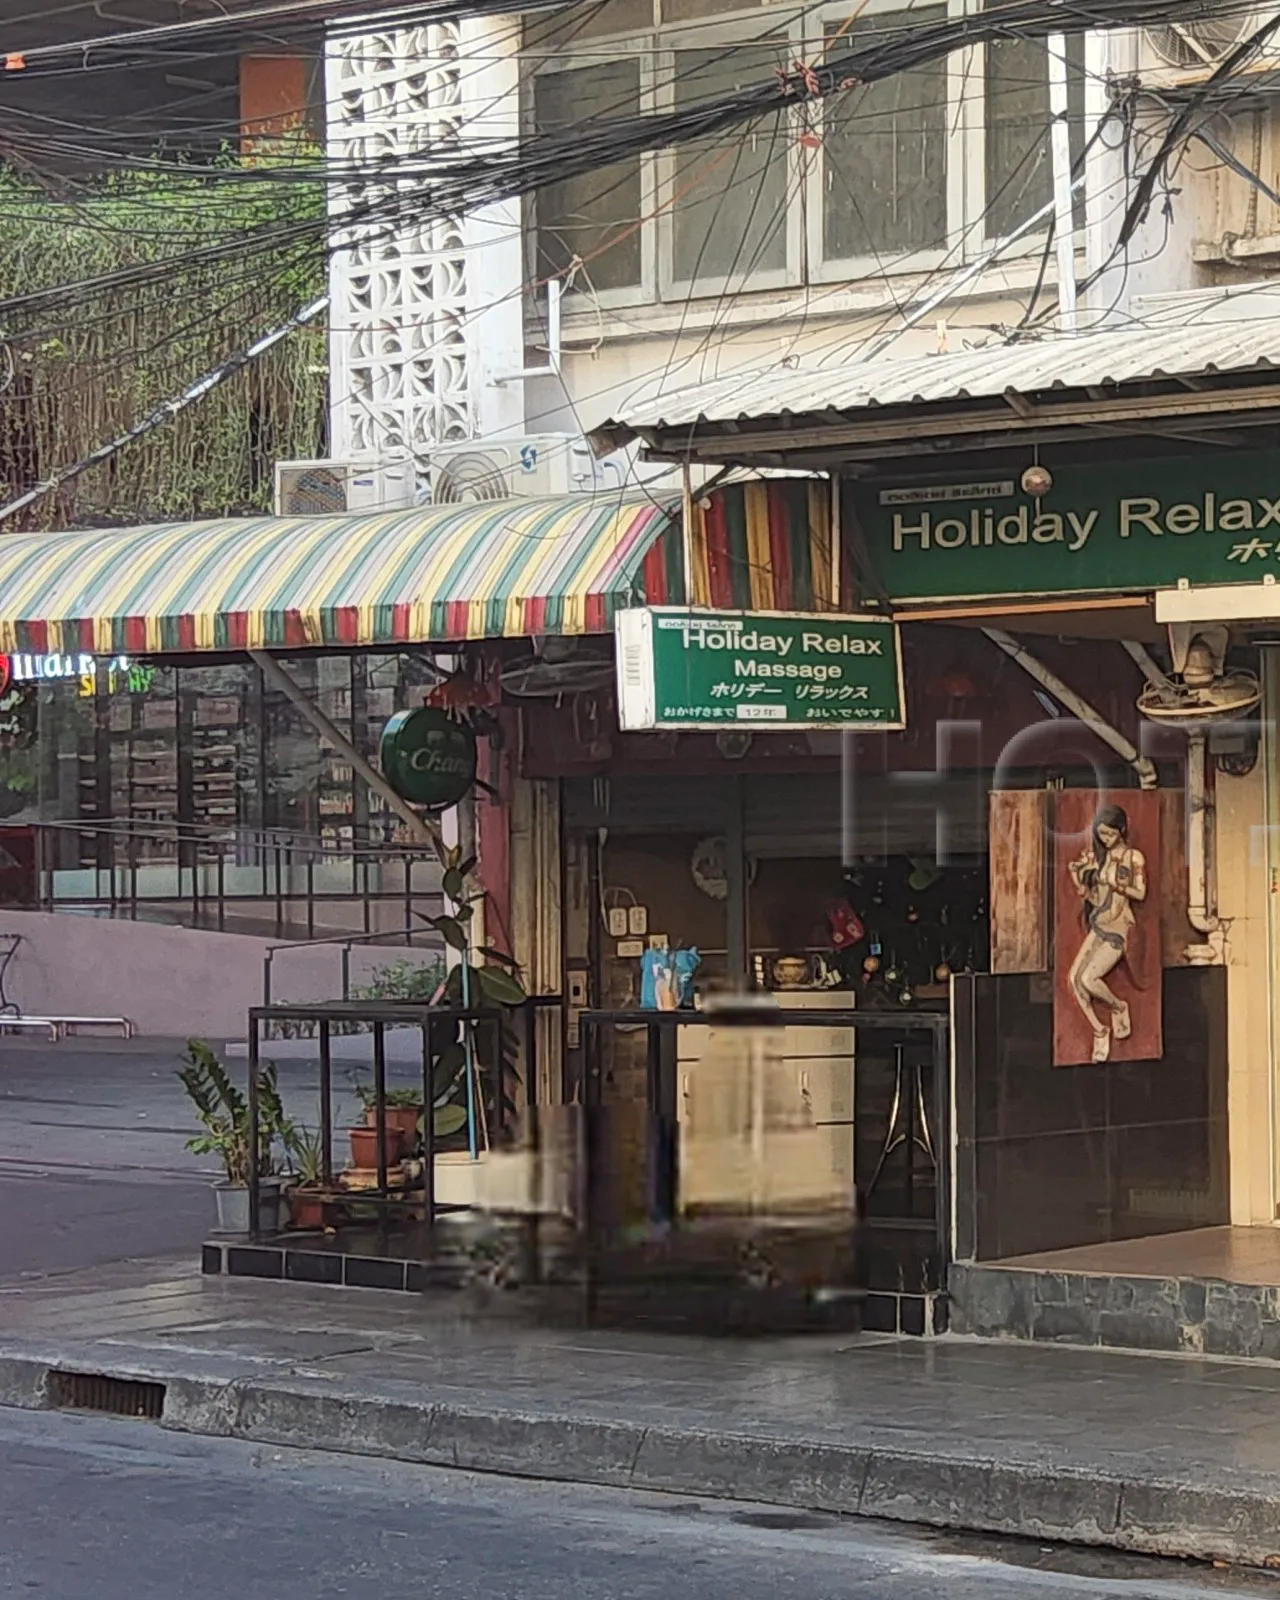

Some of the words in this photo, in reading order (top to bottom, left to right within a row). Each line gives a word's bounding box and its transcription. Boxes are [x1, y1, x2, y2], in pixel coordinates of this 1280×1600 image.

[892, 505, 1098, 550] Holiday
[682, 628, 793, 656] Holiday
[802, 633, 882, 655] Relax
[734, 659, 842, 681] Massage
[709, 682, 783, 698] ホリデー
[795, 684, 868, 700] リラックス
